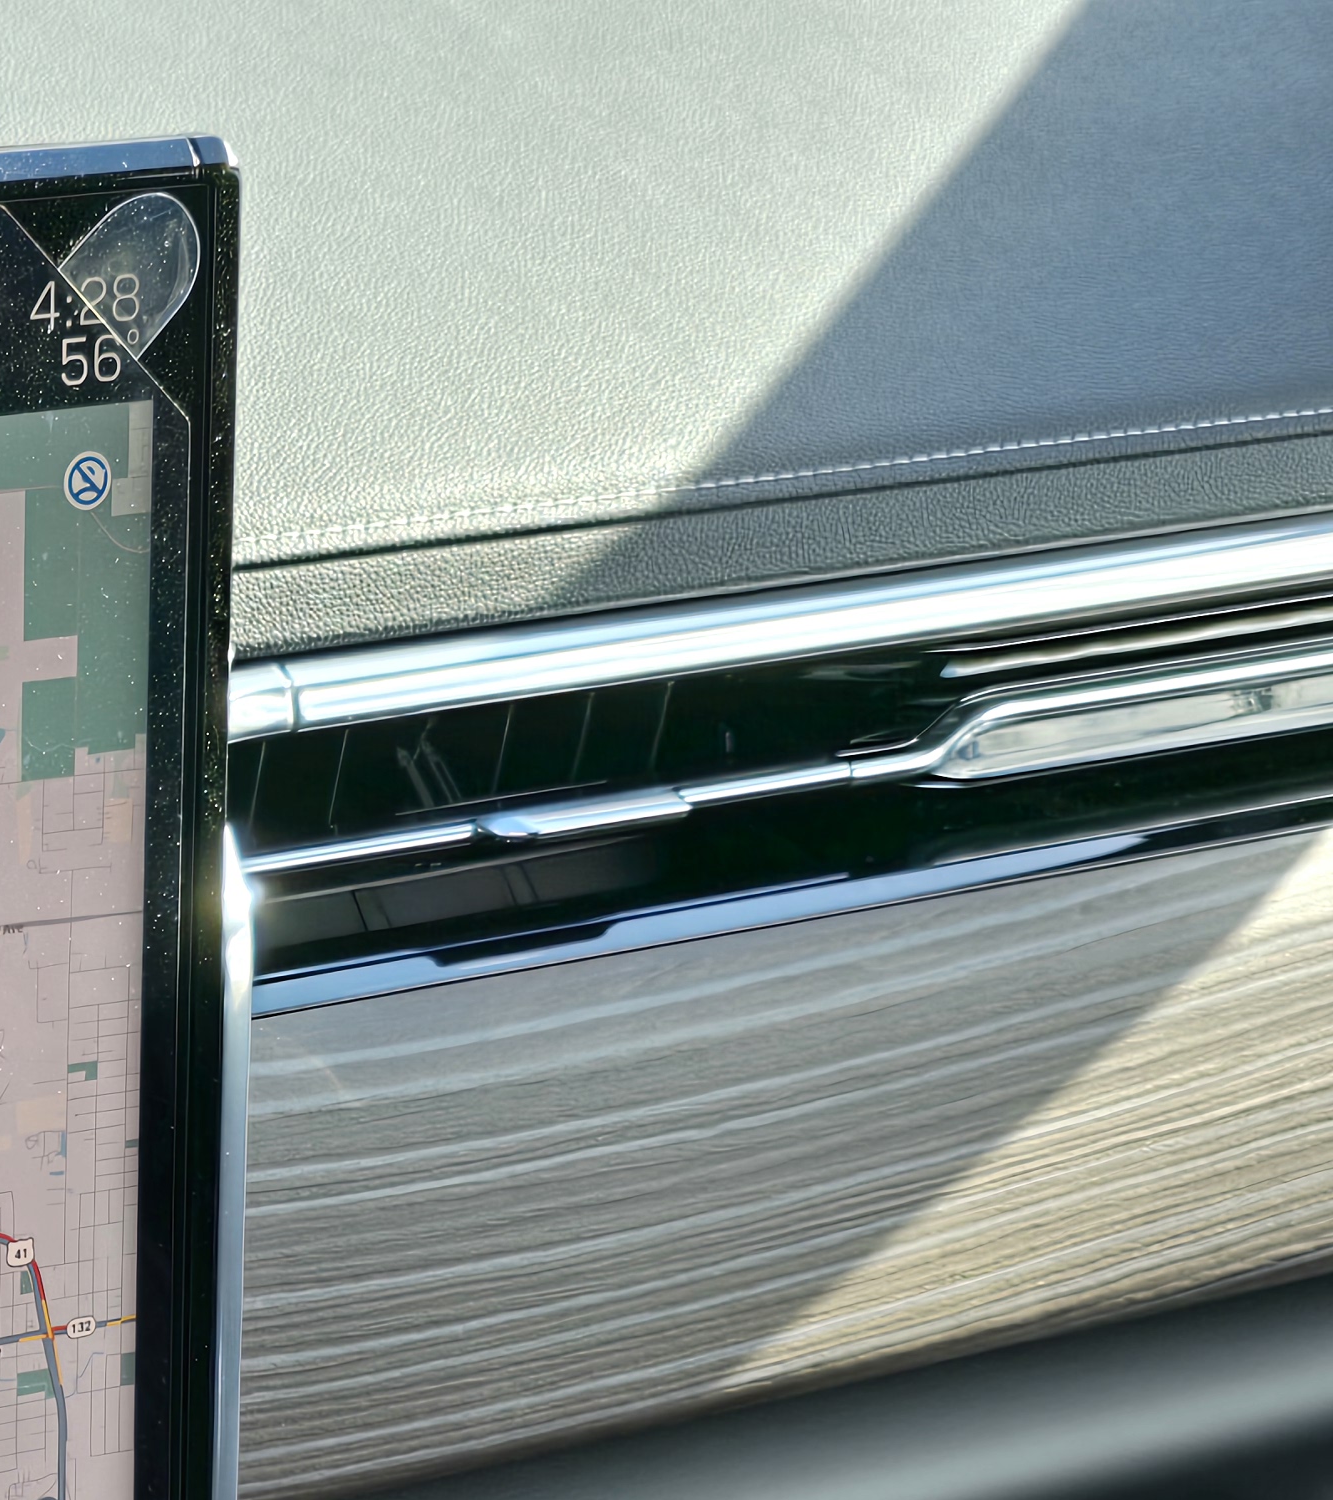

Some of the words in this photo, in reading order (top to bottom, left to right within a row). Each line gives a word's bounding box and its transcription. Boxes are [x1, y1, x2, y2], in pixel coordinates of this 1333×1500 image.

[30, 274, 139, 333] 4:28
[14, 1247, 28, 1260] 41
[71, 1320, 91, 1334] 132
